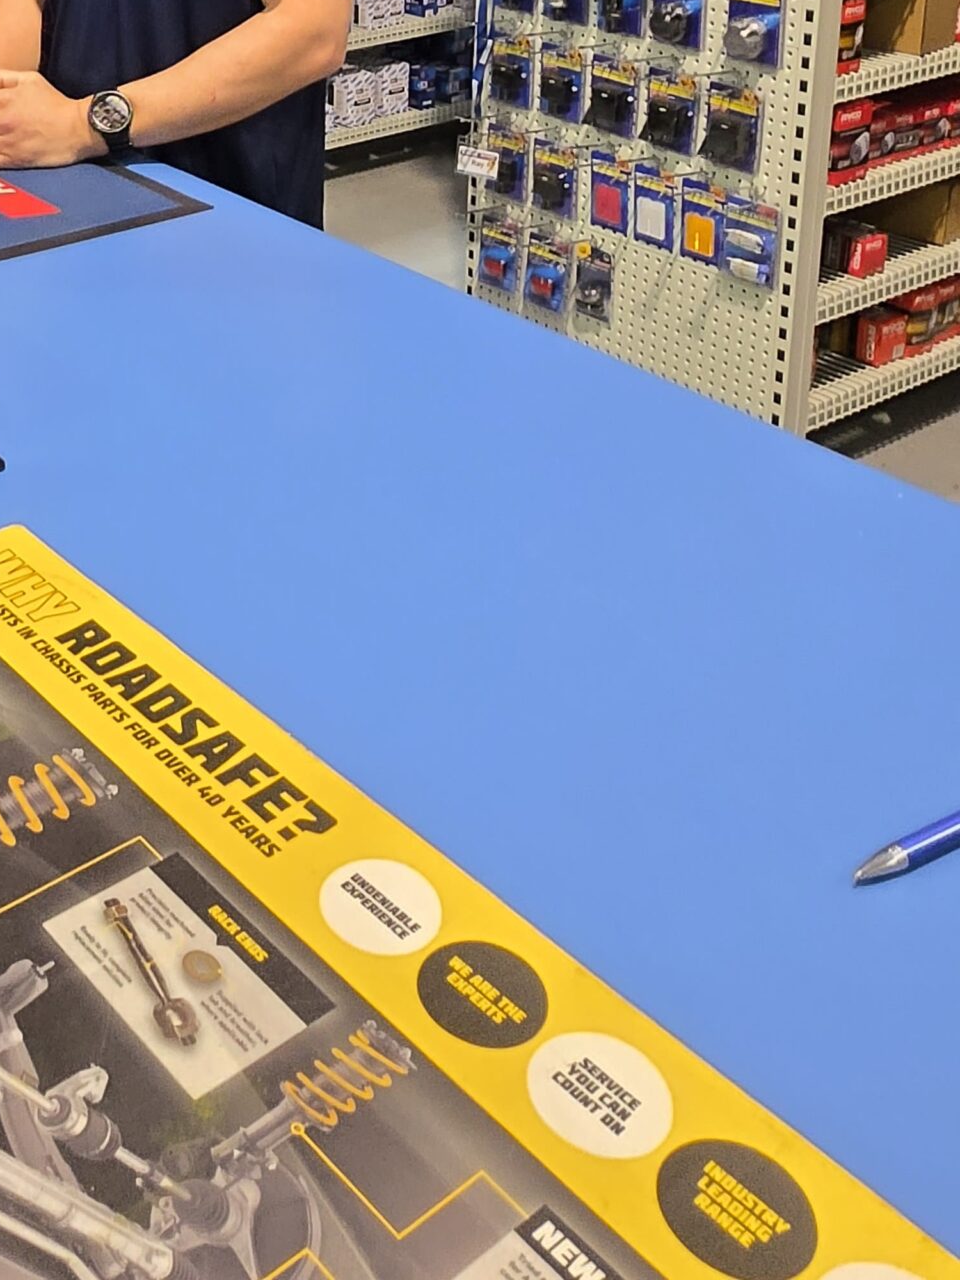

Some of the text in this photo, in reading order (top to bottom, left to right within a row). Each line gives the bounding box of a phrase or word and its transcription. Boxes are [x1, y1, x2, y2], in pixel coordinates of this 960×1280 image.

[16, 626, 38, 640] IN
[31, 639, 88, 684] CHASSIS
[81, 683, 131, 723] PARTS
[124, 721, 160, 750] FOR
[154, 748, 202, 787] OVER
[198, 785, 225, 807] 40
[222, 805, 282, 858] YEARS
[54, 619, 338, 842] ROADSAFE?
[208, 904, 269, 963] RACK ENDS
[340, 880, 410, 940] EXPERIENCE
[350, 873, 421, 934] UNDENIABLE
[446, 972, 507, 1025] EXPERTS
[449, 955, 527, 1024] WE ARE THE
[551, 1071, 626, 1136] COUNT ON
[568, 1063, 632, 1122] YOU CAN
[578, 1057, 642, 1112] SERVICE
[693, 1193, 756, 1248] RANGE
[697, 1175, 773, 1243] LEADING
[703, 1159, 791, 1234] INDUSTRY
[532, 1220, 607, 1280] NEW
